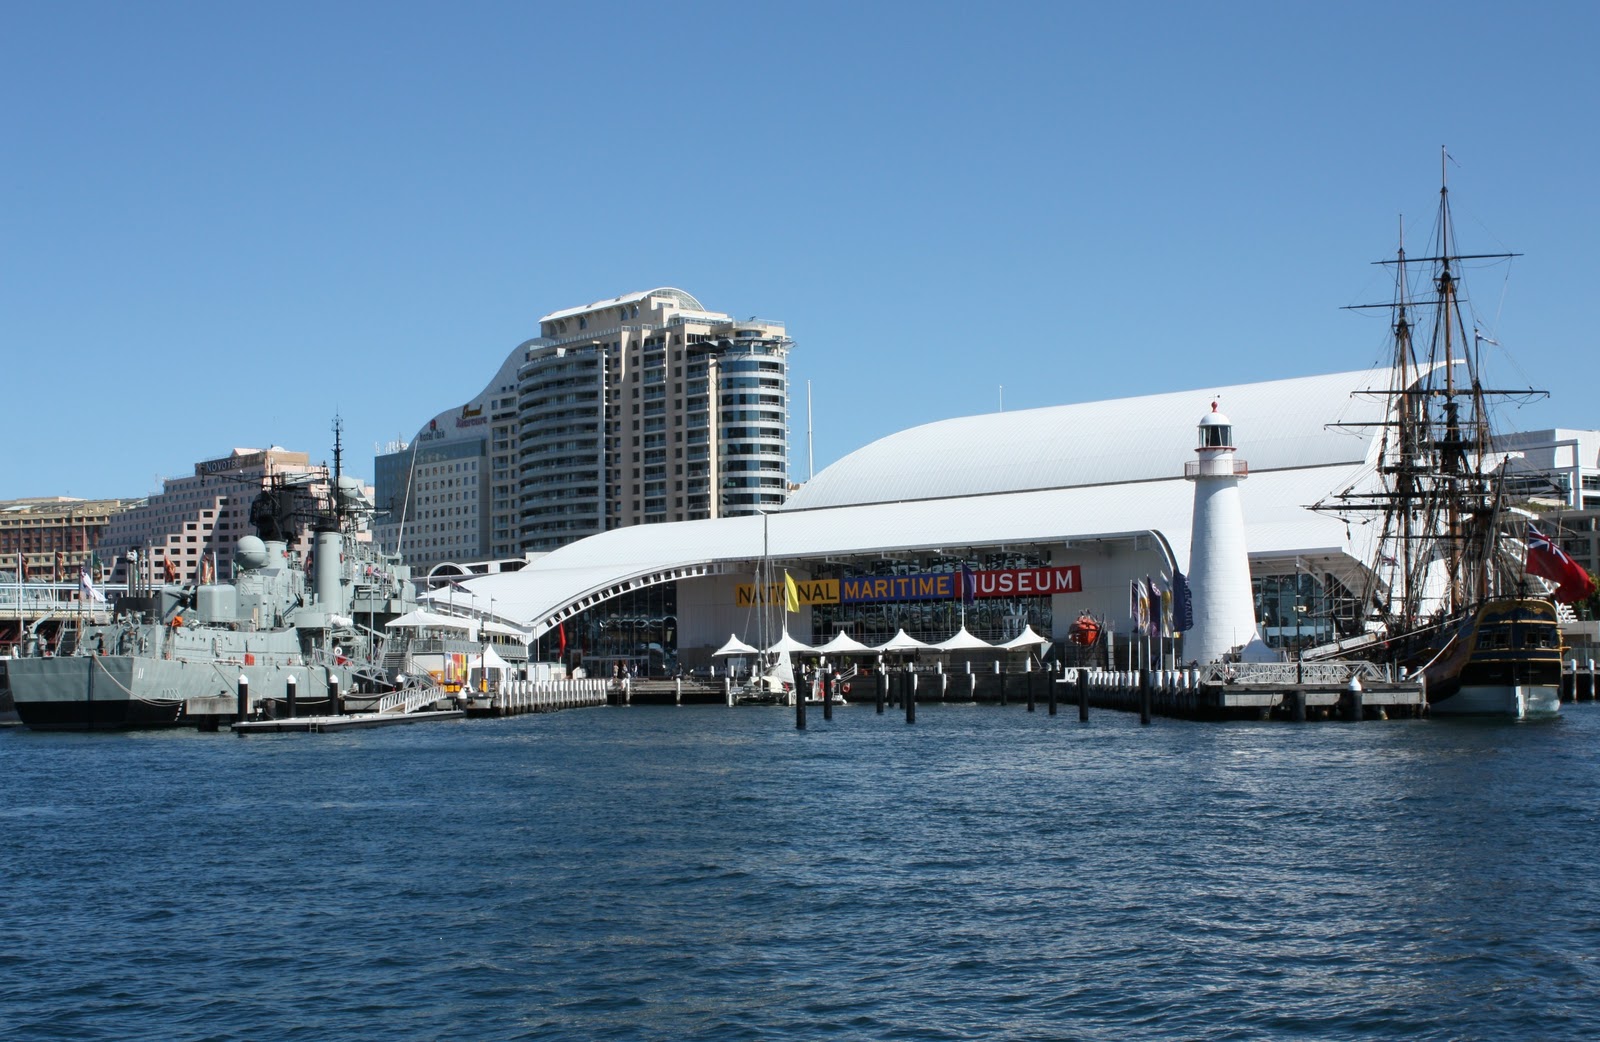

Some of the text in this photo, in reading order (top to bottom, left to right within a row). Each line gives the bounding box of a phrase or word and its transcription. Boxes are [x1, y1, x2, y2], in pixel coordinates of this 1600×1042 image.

[206, 459, 241, 472] NOVOTEL
[844, 576, 950, 599] MARITIME
[963, 570, 1073, 593] USEUM
